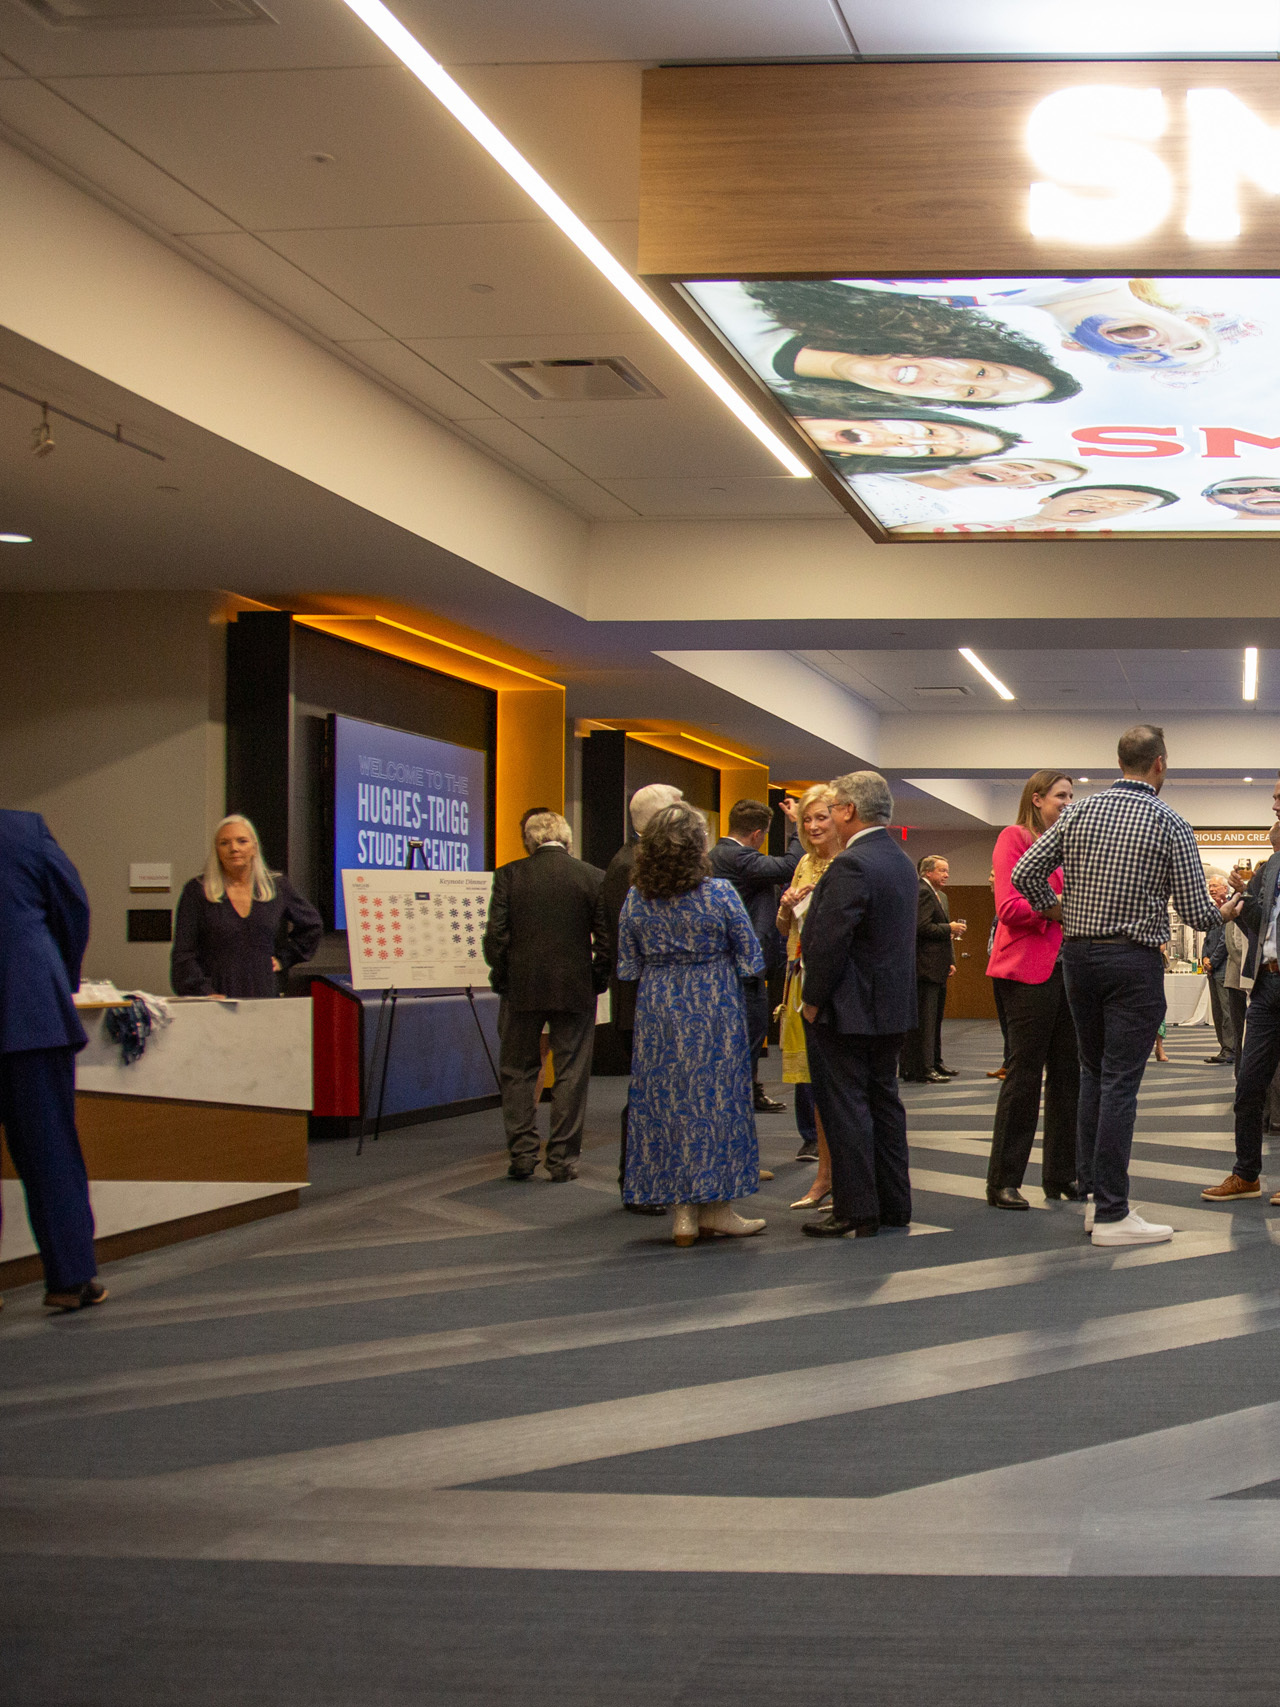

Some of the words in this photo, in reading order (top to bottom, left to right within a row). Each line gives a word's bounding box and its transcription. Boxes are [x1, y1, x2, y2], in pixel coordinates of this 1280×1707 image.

[358, 754, 424, 787] WELCOME
[425, 768, 442, 790] TO
[444, 772, 469, 796] THE
[358, 782, 469, 836] HUGHES-TRIGG
[422, 837, 469, 872] CENTER
[1194, 833, 1222, 842] RIOUS
[1223, 833, 1245, 842] AND
[1246, 833, 1270, 842] CREA
